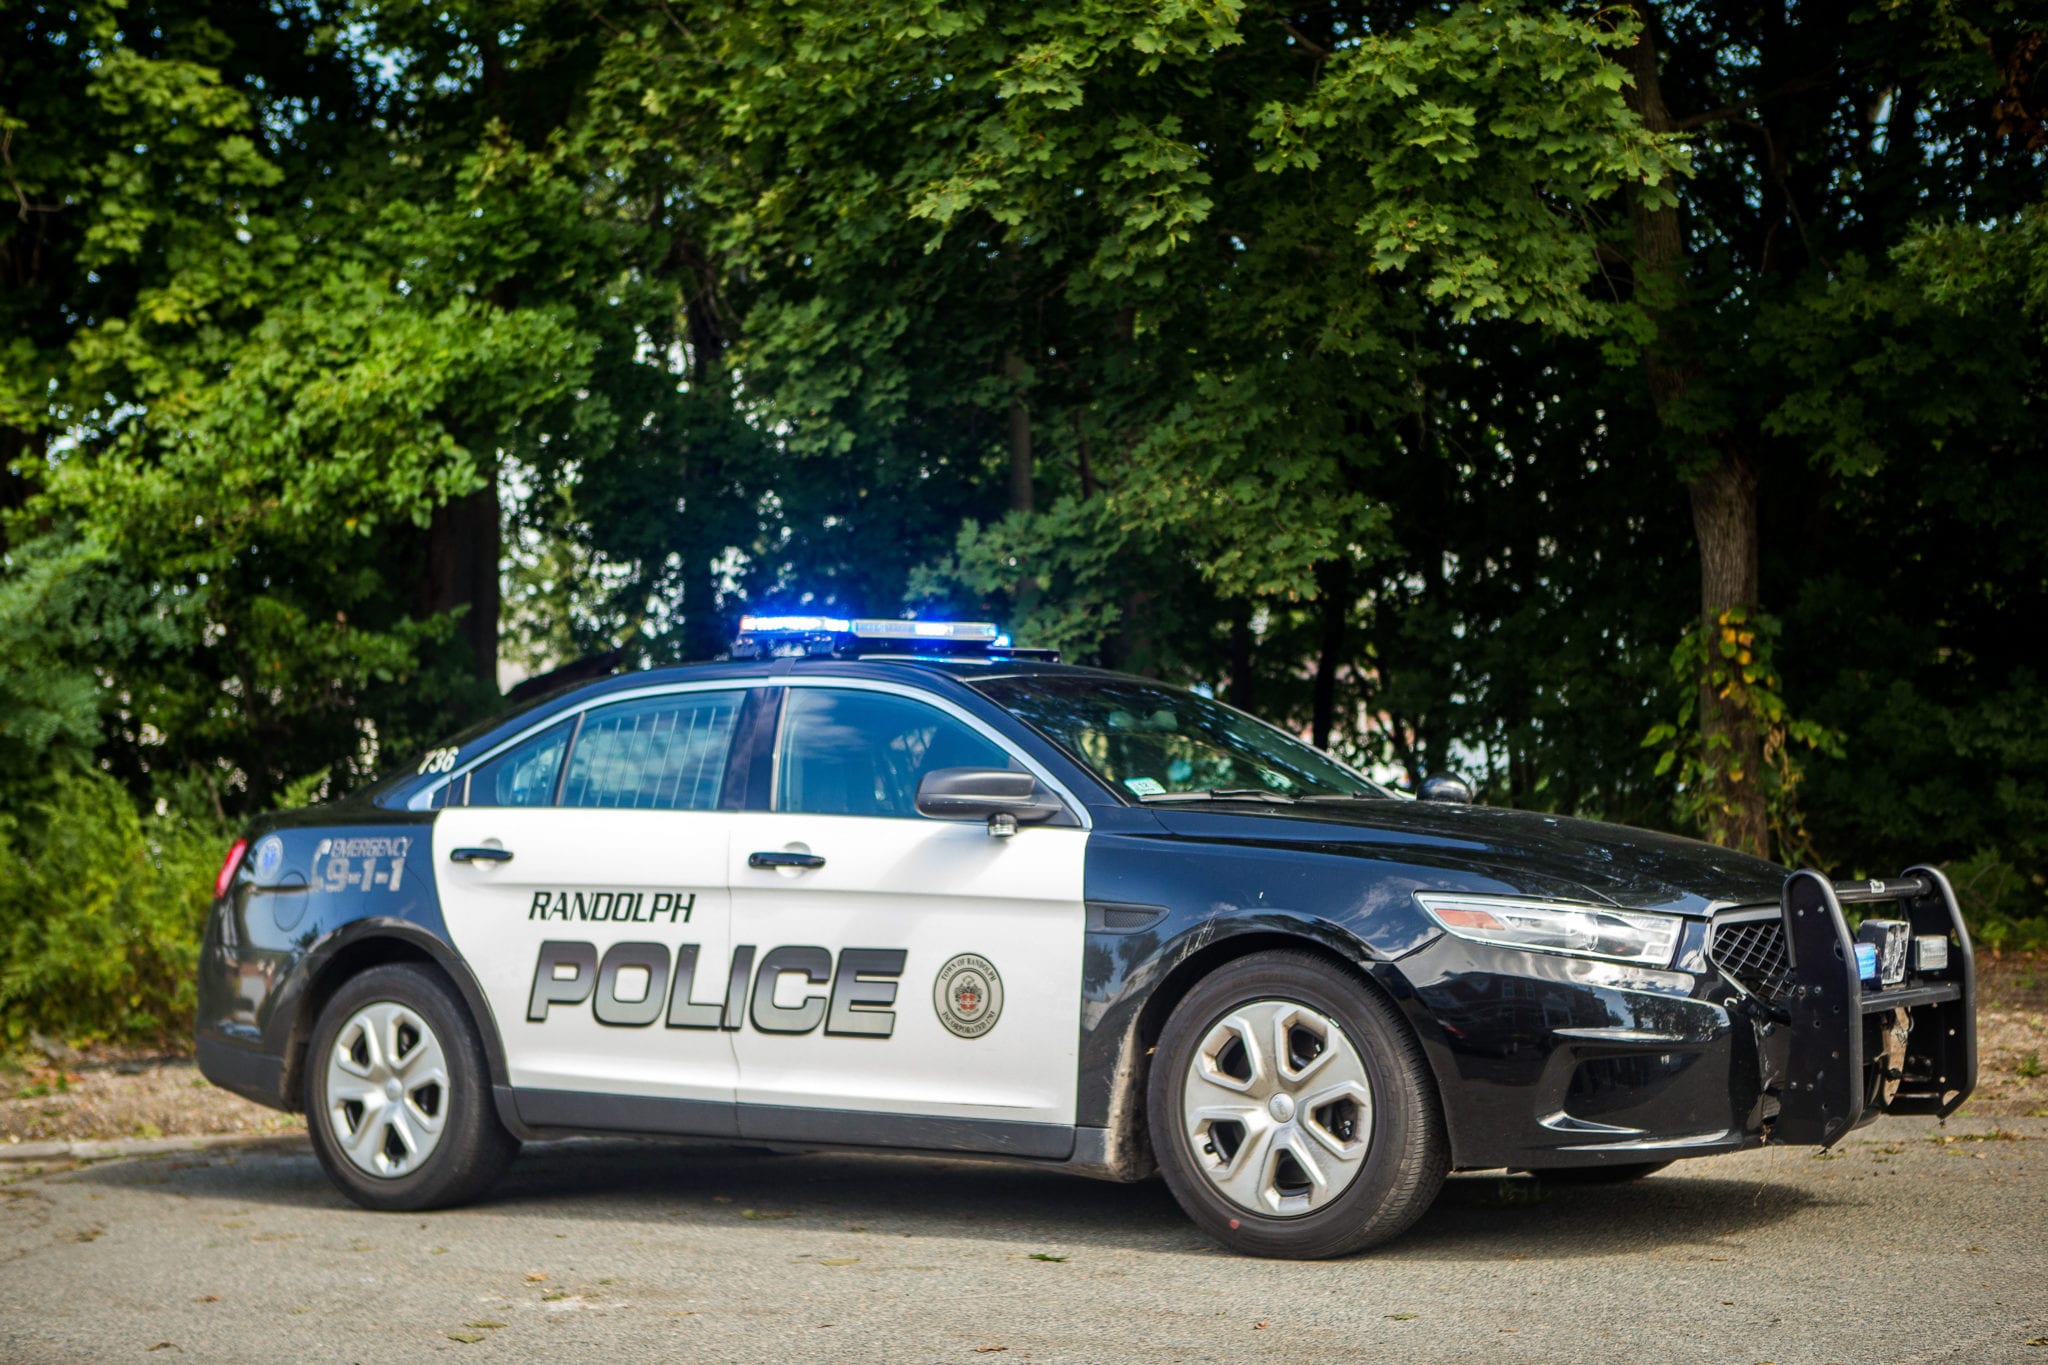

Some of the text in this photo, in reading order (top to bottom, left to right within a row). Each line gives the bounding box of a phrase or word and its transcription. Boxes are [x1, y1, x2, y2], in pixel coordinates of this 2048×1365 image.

[331, 837, 413, 858] EMERGENCY
[325, 858, 405, 892] 9-1-1
[528, 891, 696, 923] RANDOLPH
[526, 940, 908, 1038] POLICE
